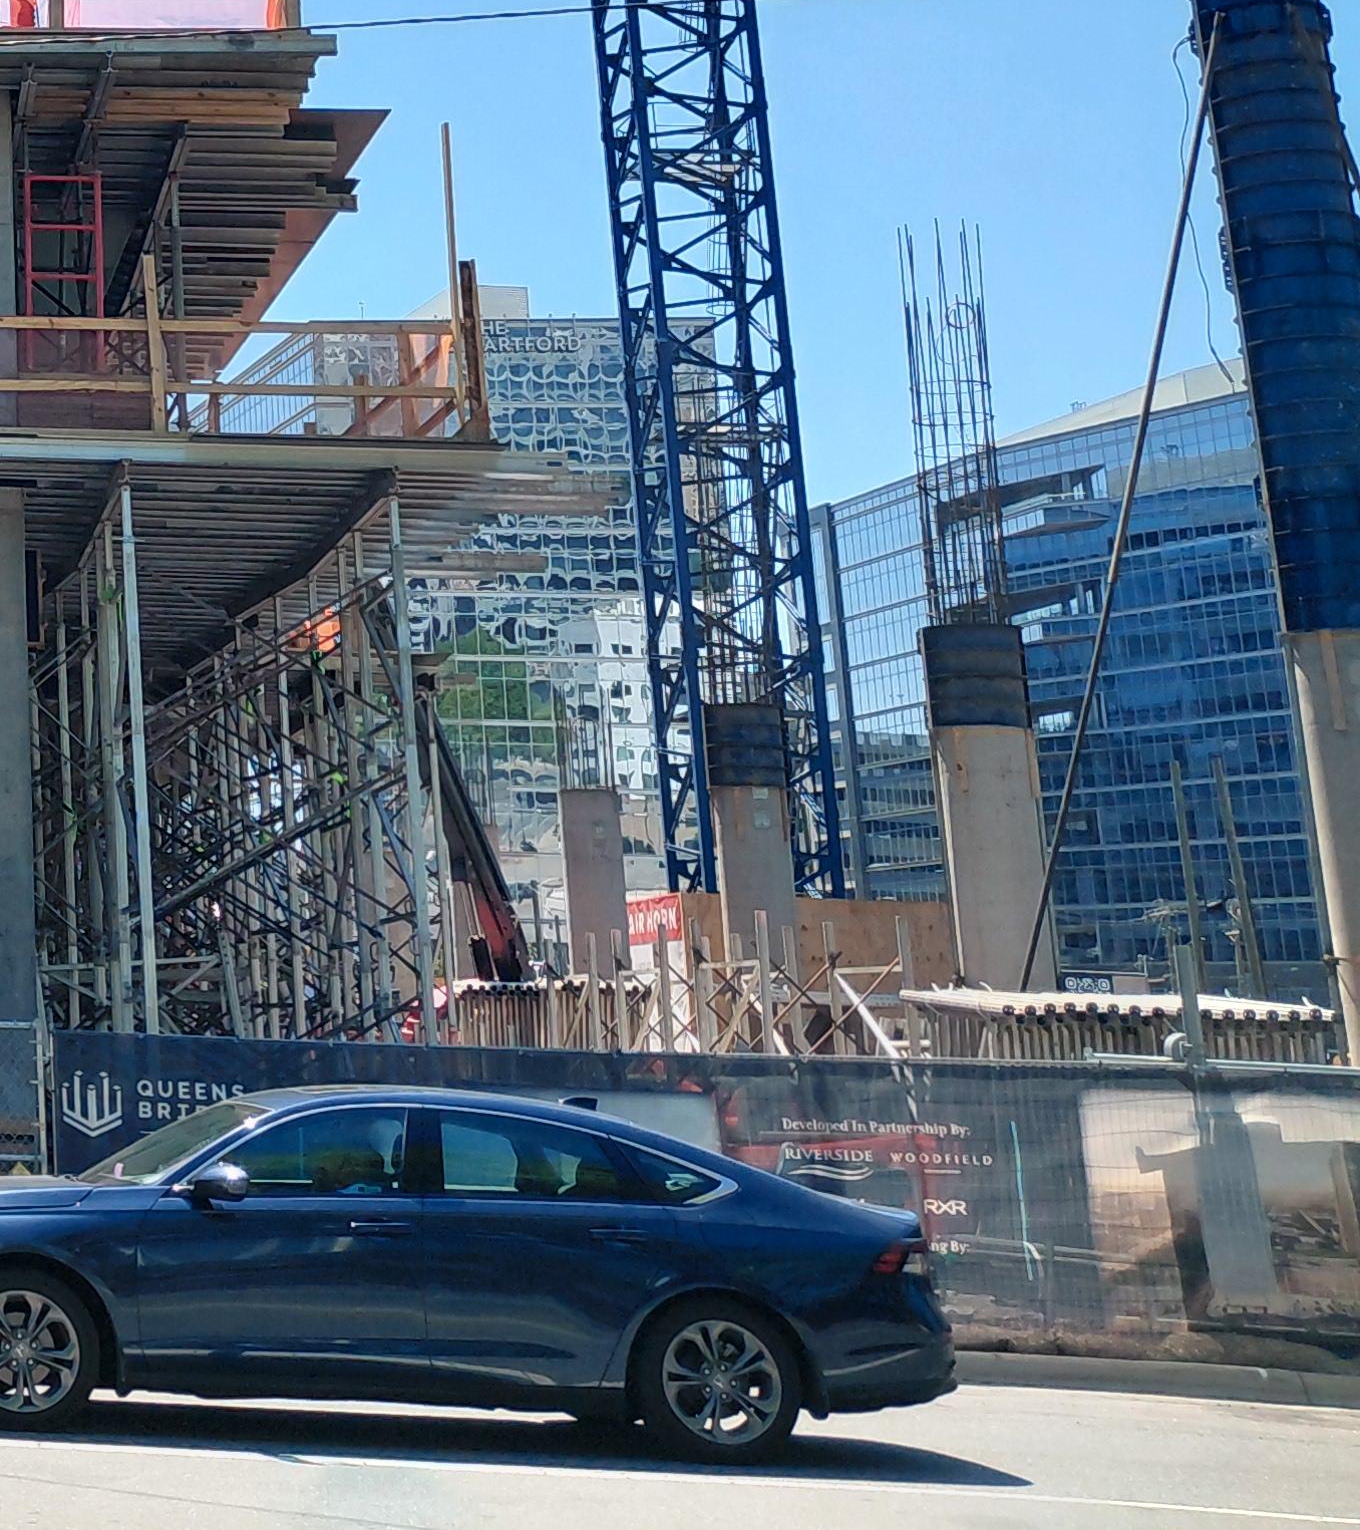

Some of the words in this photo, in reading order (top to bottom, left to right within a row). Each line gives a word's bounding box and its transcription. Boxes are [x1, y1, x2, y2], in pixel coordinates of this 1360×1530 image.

[481, 320, 506, 335] HE
[483, 337, 580, 351] ARTFORD
[137, 1080, 244, 1100] QUEENS
[138, 1102, 206, 1122] BRI
[782, 1117, 849, 1134] Developed
[852, 1120, 867, 1132] In
[870, 1121, 947, 1138] Partnership
[950, 1123, 971, 1139] By:
[785, 1149, 873, 1162] RIVERSIDE
[890, 1152, 993, 1166] WOODFIELD
[923, 1199, 968, 1215] RXR
[950, 1240, 970, 1254] By:
